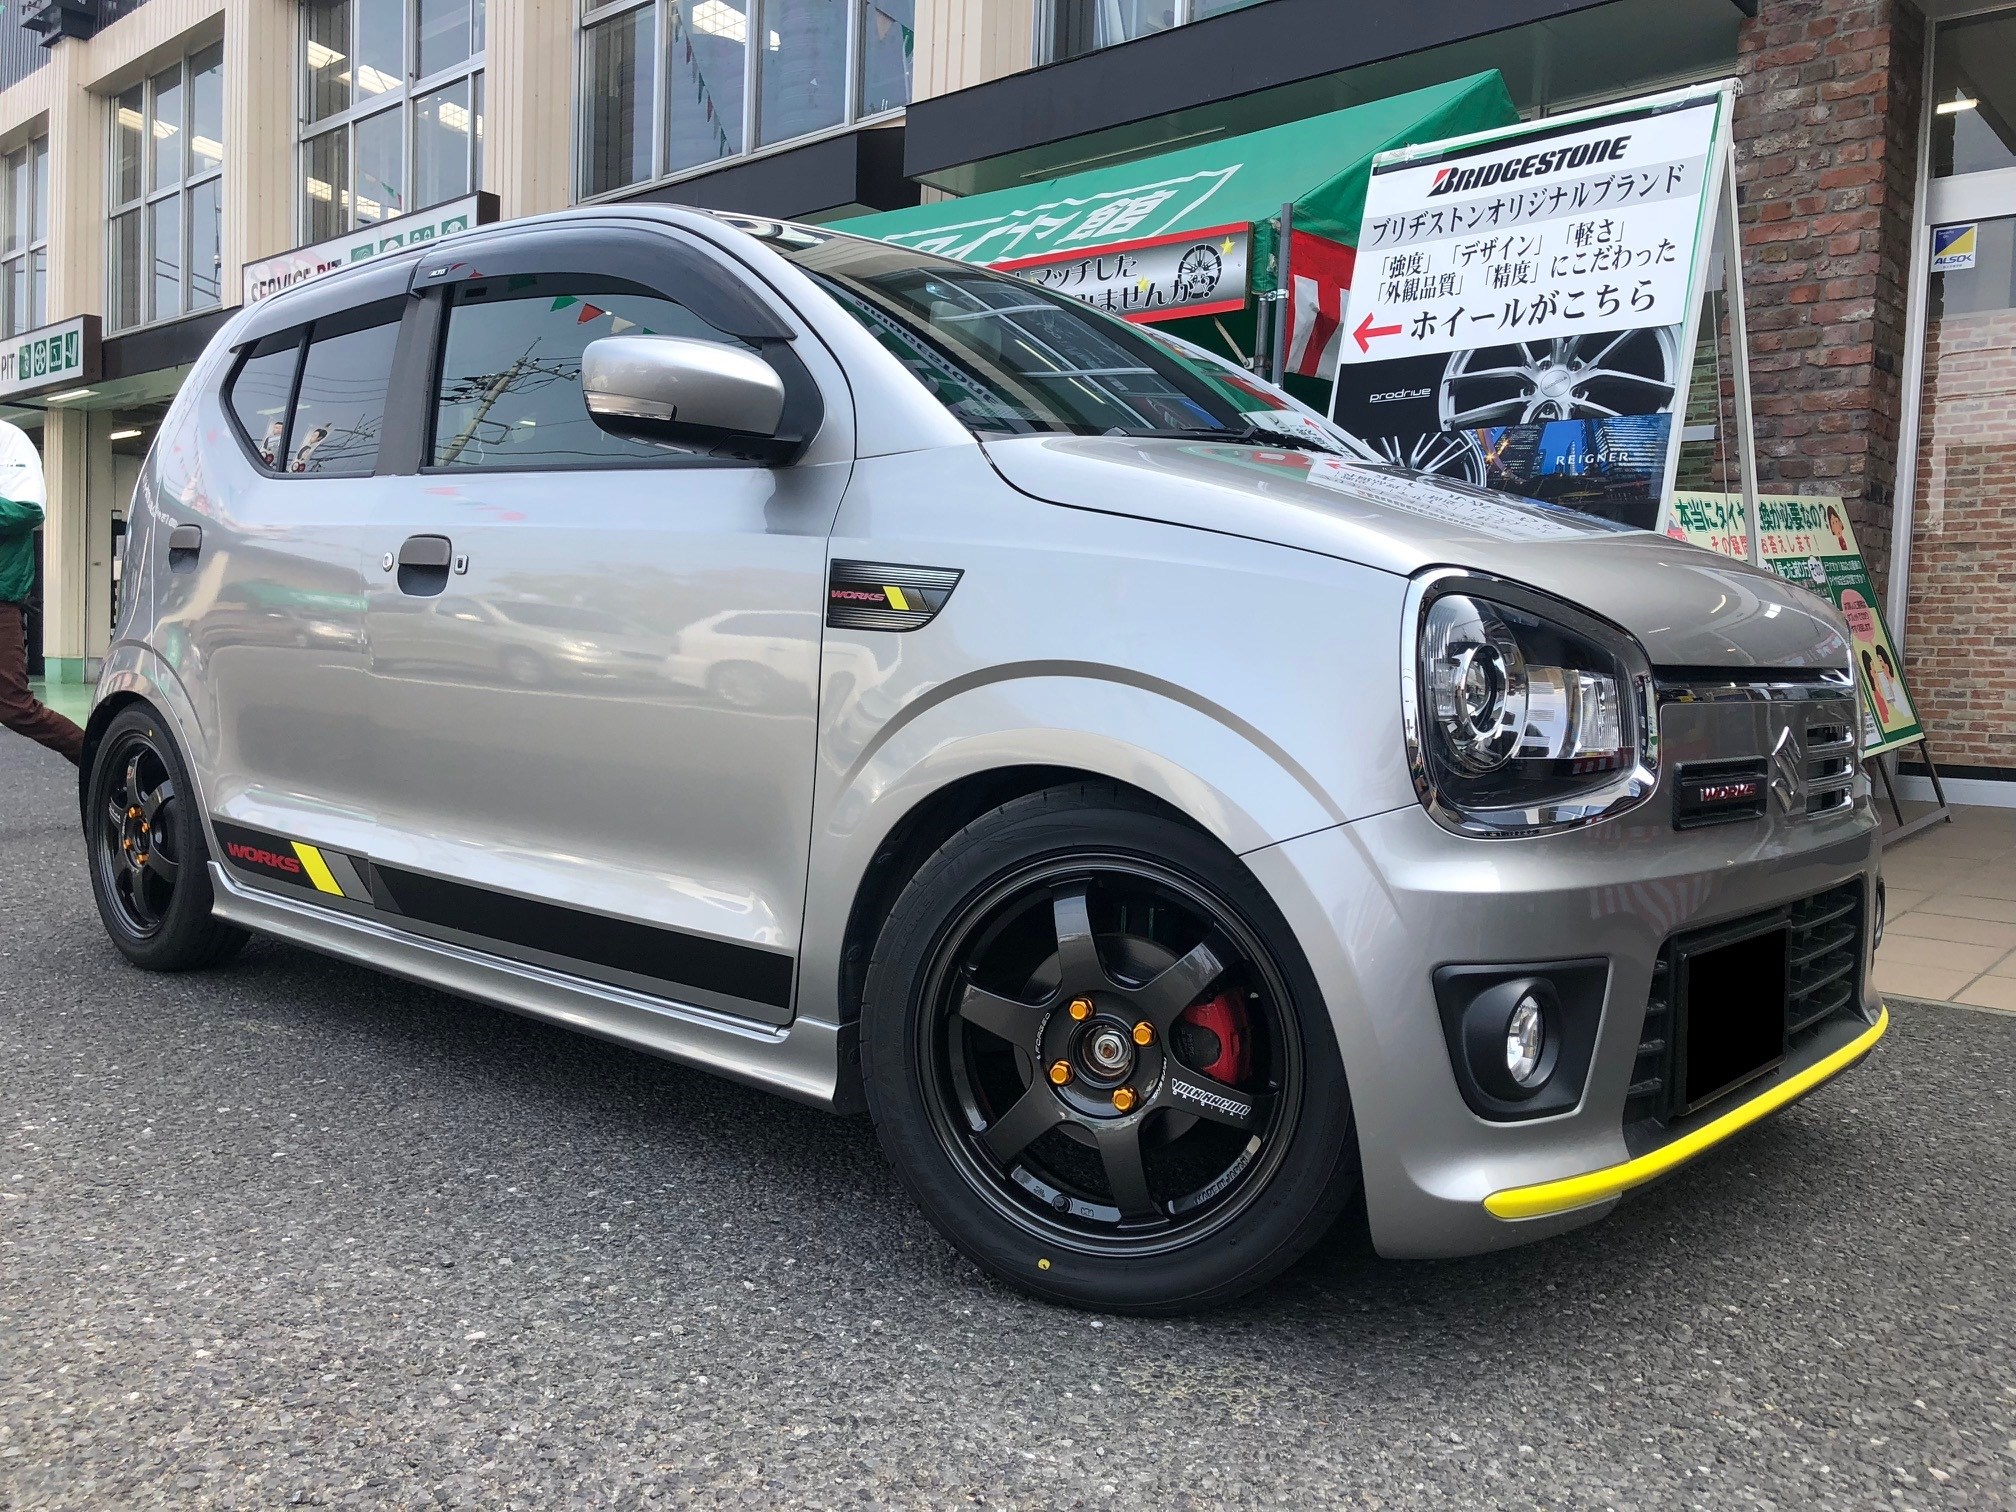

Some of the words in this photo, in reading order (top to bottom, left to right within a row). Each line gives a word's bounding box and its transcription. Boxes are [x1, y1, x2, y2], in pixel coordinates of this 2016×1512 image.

[1427, 135, 1632, 198] BRIDGESTONE
[1372, 164, 1685, 247] ブリヂストンオリジナルブランド
[1016, 254, 1137, 287] マッチした
[1934, 254, 1972, 265] ALSOK
[1411, 280, 1656, 340] ホイールがこちら
[1, 353, 15, 381] PIT
[1369, 387, 1431, 403] prodrive
[1556, 451, 1630, 465] REIGNER
[1675, 497, 1829, 532] 本当にタイヤ換が必要なの?
[1711, 534, 1820, 556] その疑問お答えします!
[831, 589, 886, 602] WORKS
[1700, 783, 1757, 802] WORKS
[227, 841, 301, 873] WORKS
